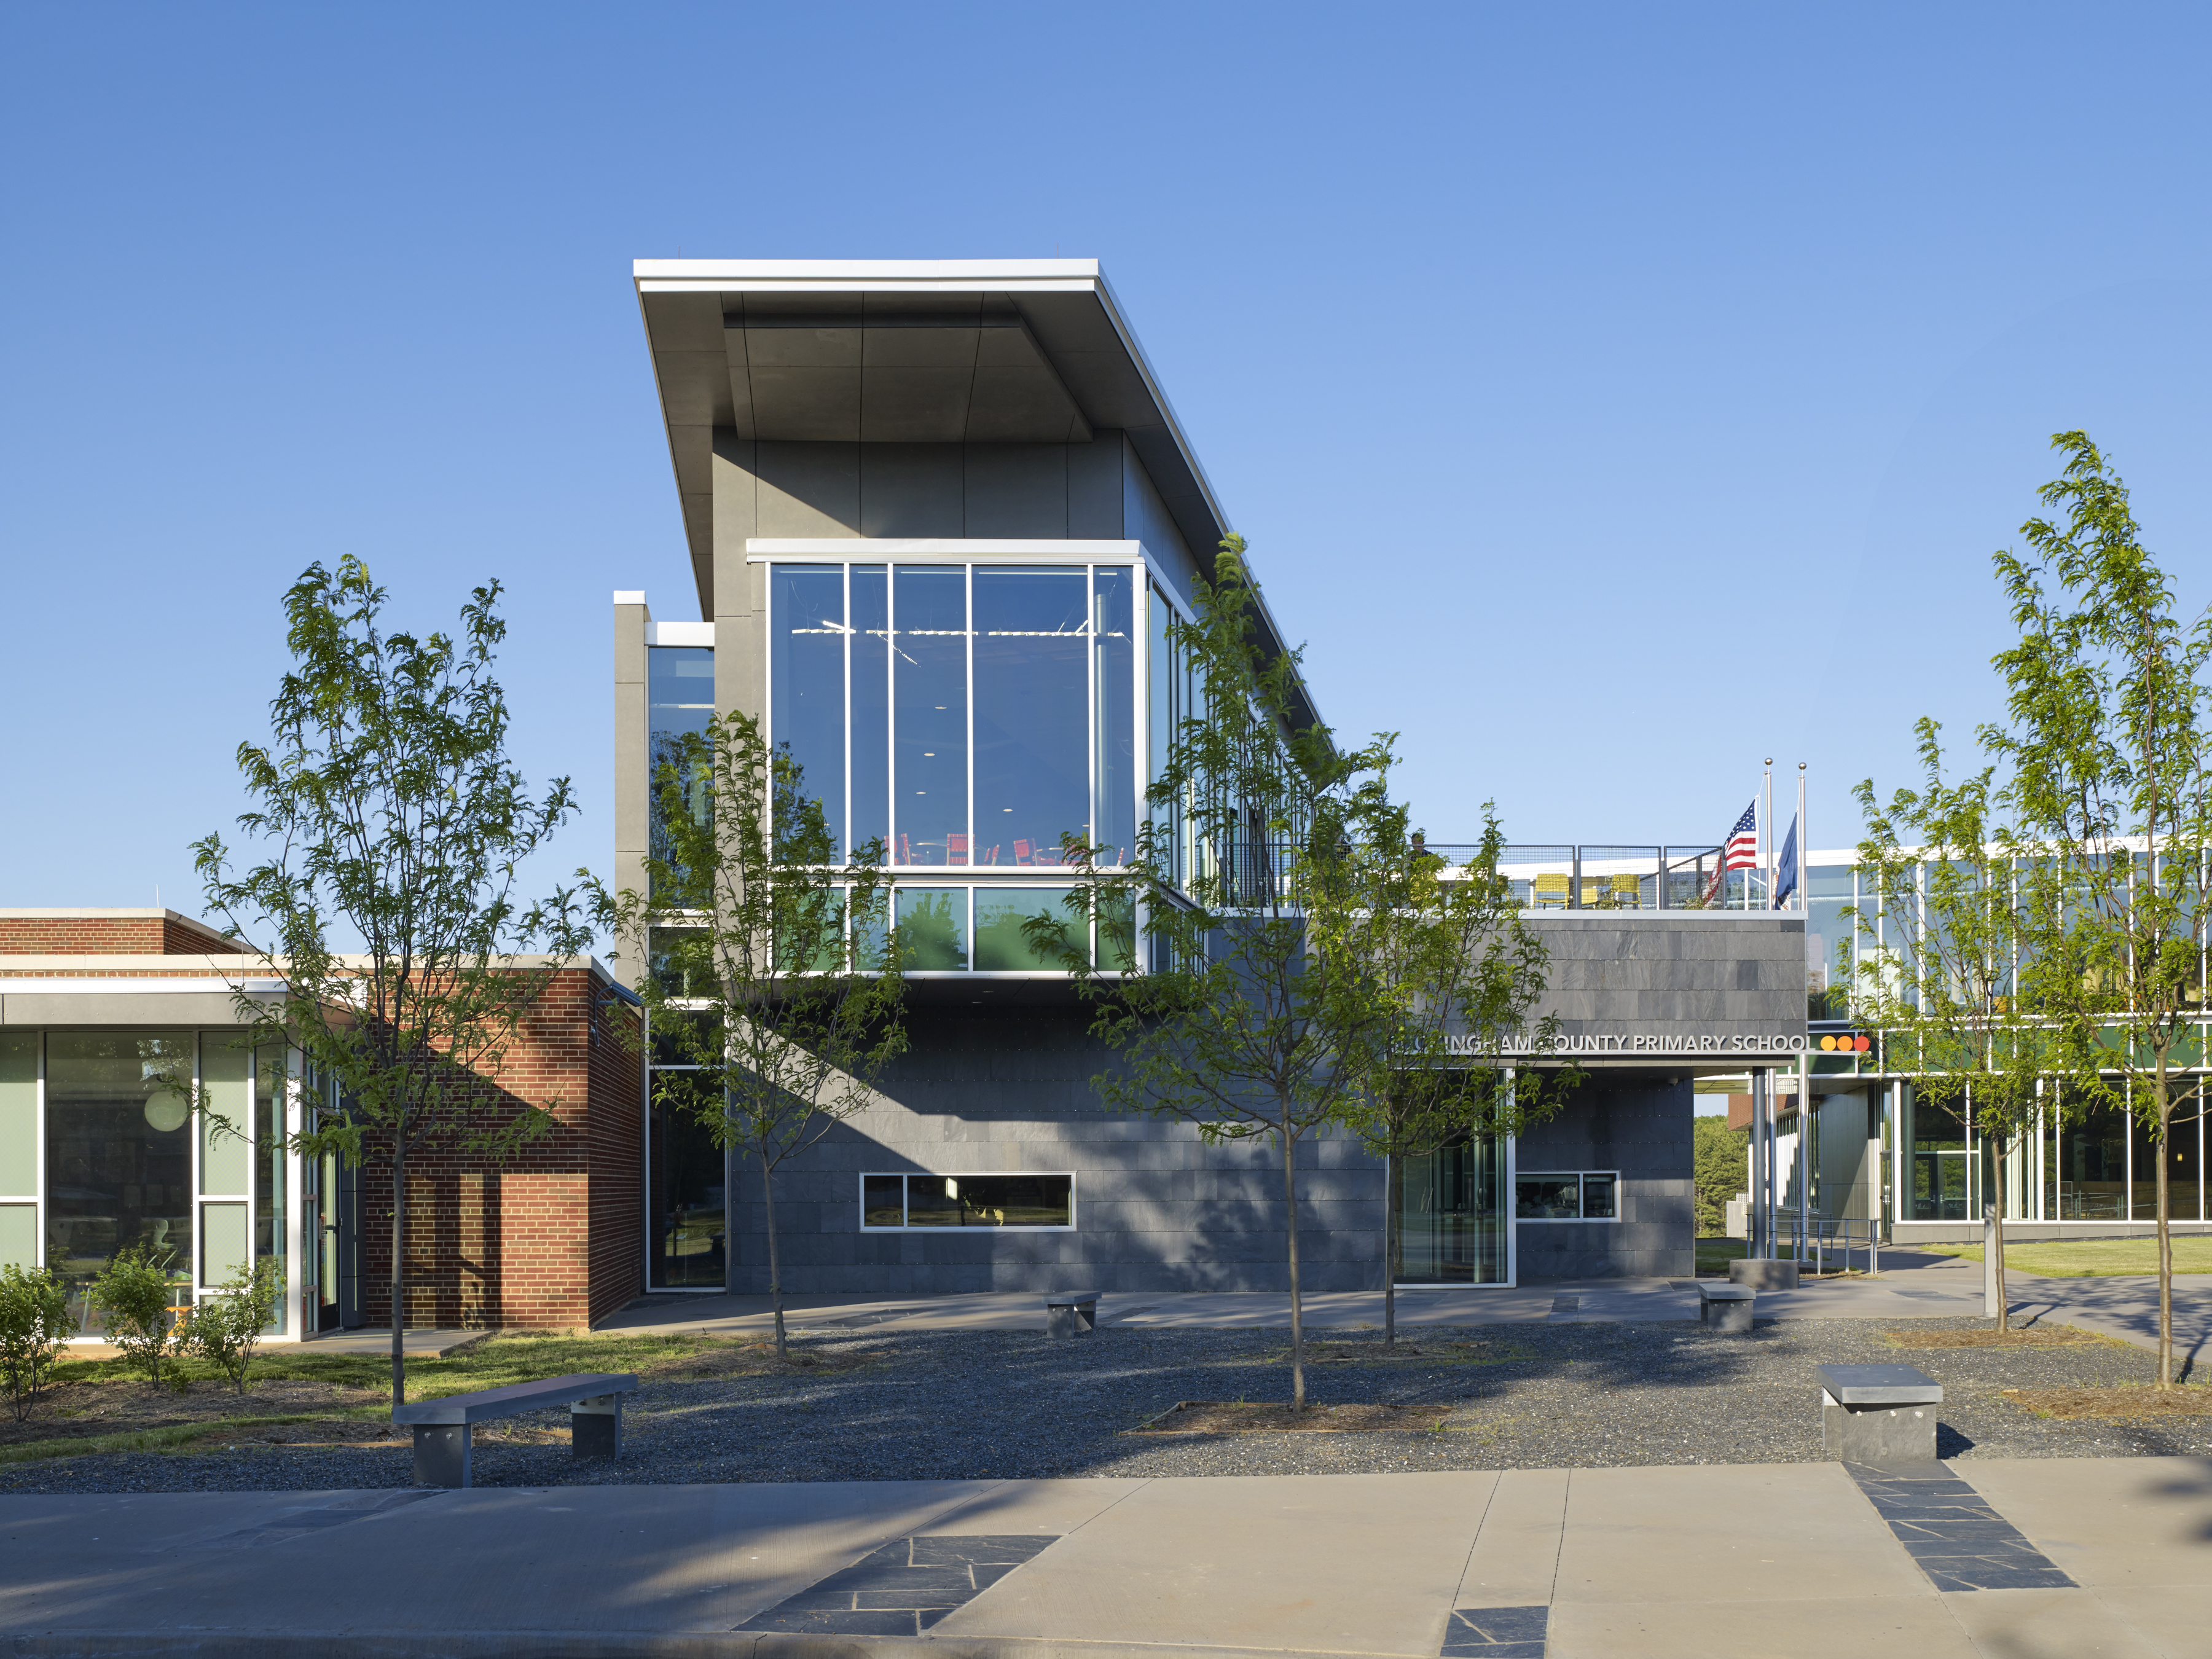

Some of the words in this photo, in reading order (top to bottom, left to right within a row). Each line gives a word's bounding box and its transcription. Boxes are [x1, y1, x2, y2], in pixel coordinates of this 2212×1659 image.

[1390, 1035, 1532, 1051] CINGHAM
[1633, 1035, 1727, 1051] PRIMARY
[1731, 1035, 1816, 1051] SCHOOL
